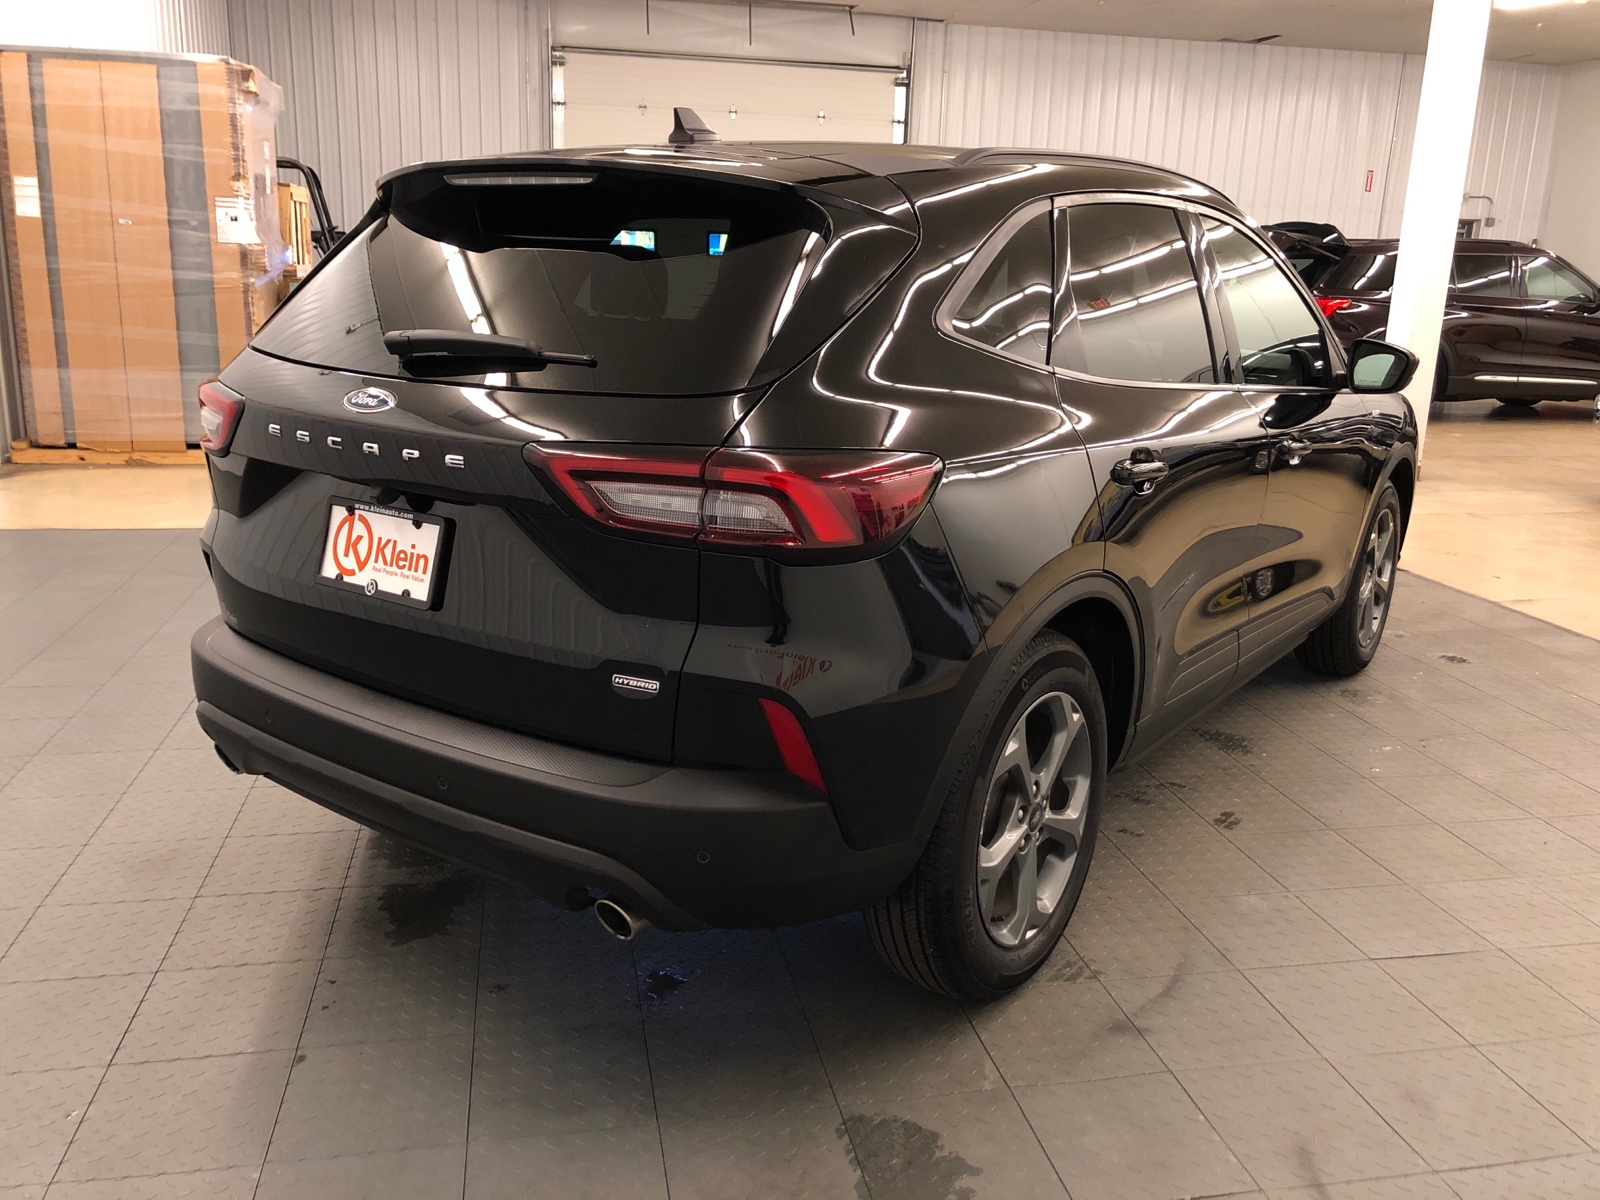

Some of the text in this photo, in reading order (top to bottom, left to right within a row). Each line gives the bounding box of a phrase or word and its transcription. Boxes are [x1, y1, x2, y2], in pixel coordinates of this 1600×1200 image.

[351, 391, 384, 406] Ford
[268, 423, 465, 469] ESCAPE
[355, 503, 414, 519] www.kleinauto.com
[374, 536, 429, 575] Klein
[372, 565, 426, 583] Real People. Real Value.
[614, 677, 658, 690] HYBRID
